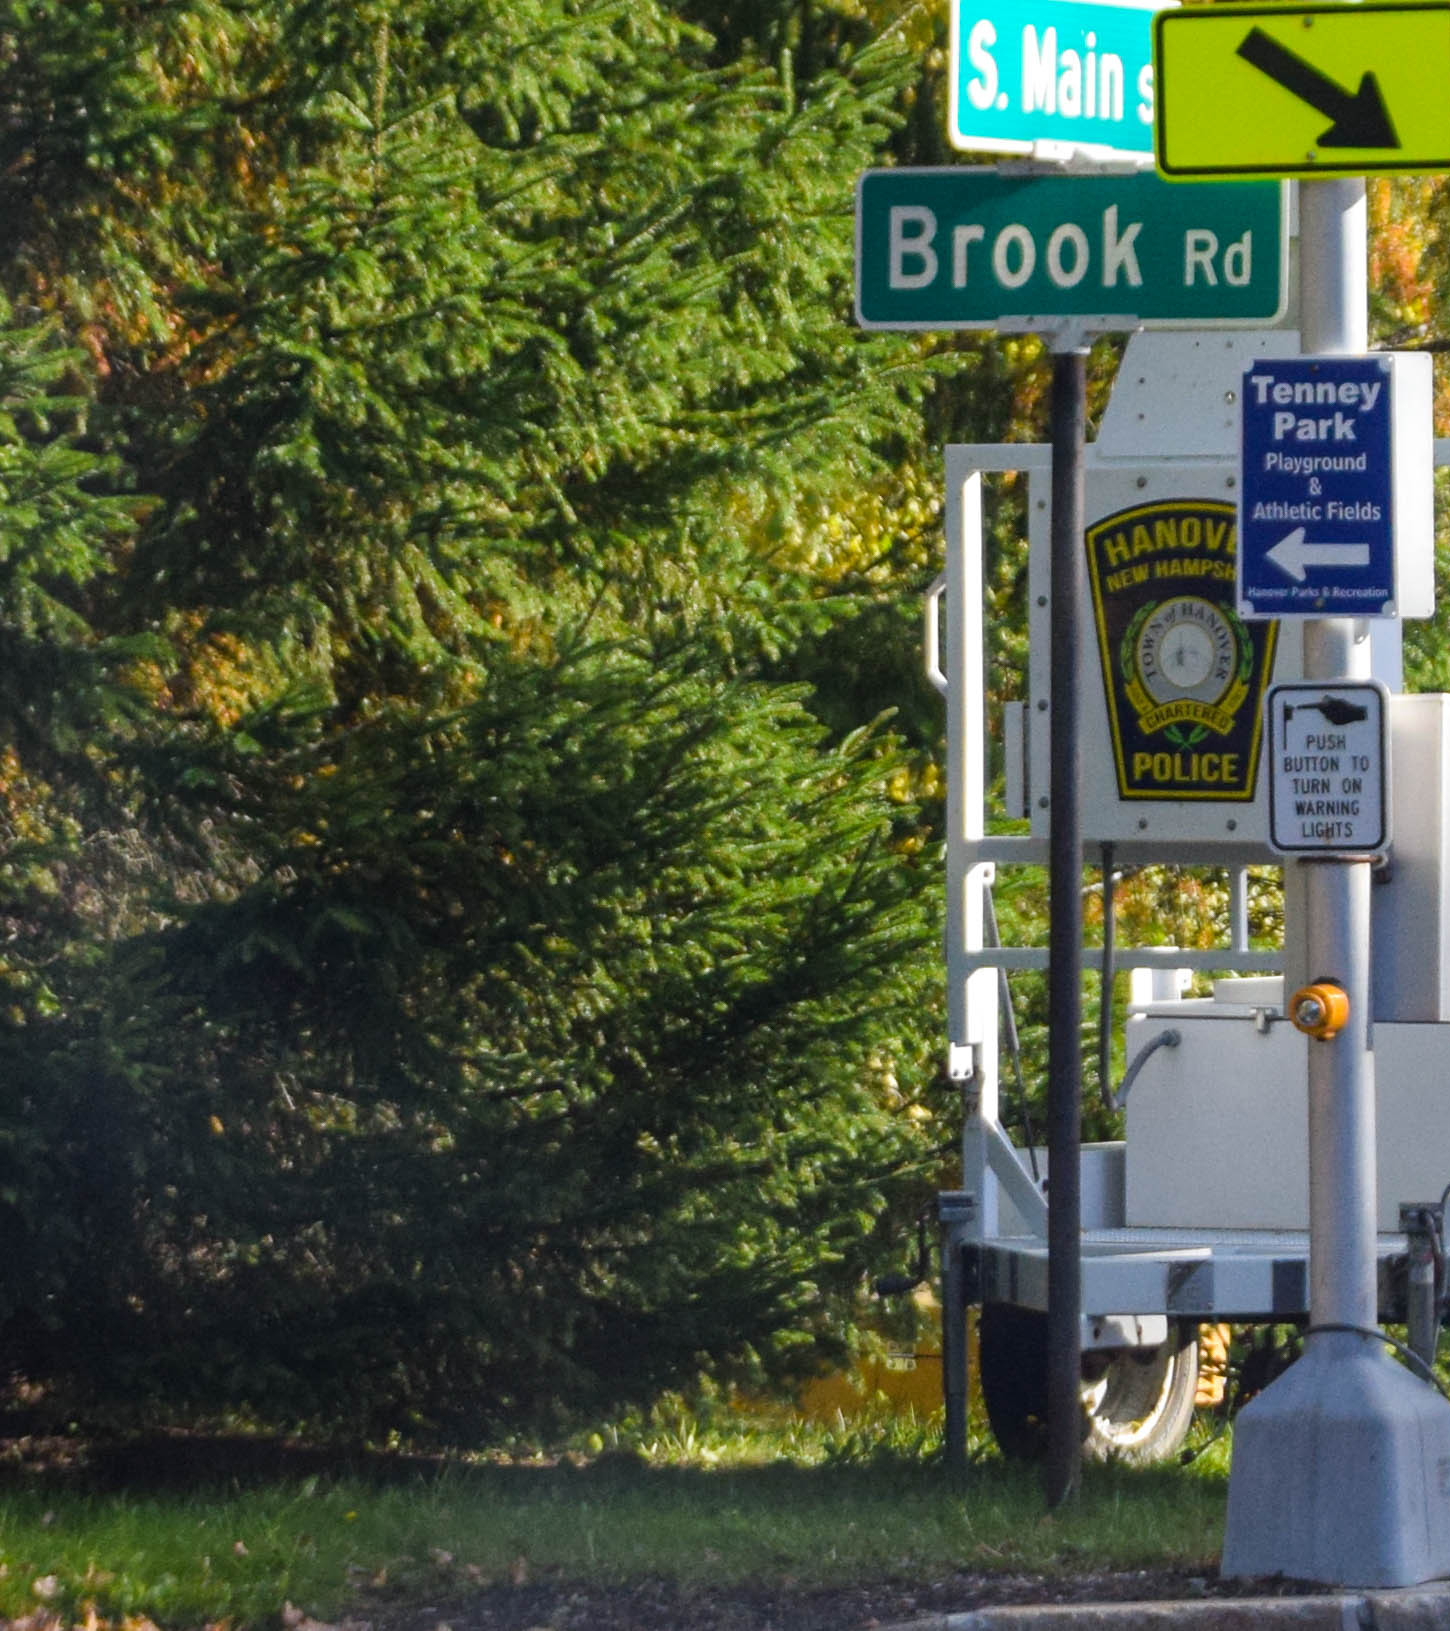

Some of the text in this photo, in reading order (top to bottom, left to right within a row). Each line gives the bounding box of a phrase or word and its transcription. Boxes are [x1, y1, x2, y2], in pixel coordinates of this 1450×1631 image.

[966, 19, 1155, 125] S. Main S
[888, 204, 1252, 289] Brook Rd
[1251, 375, 1381, 412] Tenney
[1273, 411, 1356, 440] Park
[1265, 452, 1367, 474] Playground
[1309, 477, 1322, 495] &
[1253, 502, 1382, 521] Athletic Fields
[1104, 517, 1237, 567] HANOV
[1106, 558, 1237, 592] NEW HAMPSH
[1248, 586, 1288, 597] Hanover
[1291, 586, 1320, 597] Parks
[1333, 586, 1389, 597] Recreation
[1306, 735, 1346, 750] PUSH
[1132, 752, 1239, 783] POLICE
[1284, 756, 1370, 773] BUTTON TO
[1293, 777, 1362, 794] TURN ON
[1295, 800, 1360, 816] WARNING
[1302, 822, 1353, 838] LIGHTS
